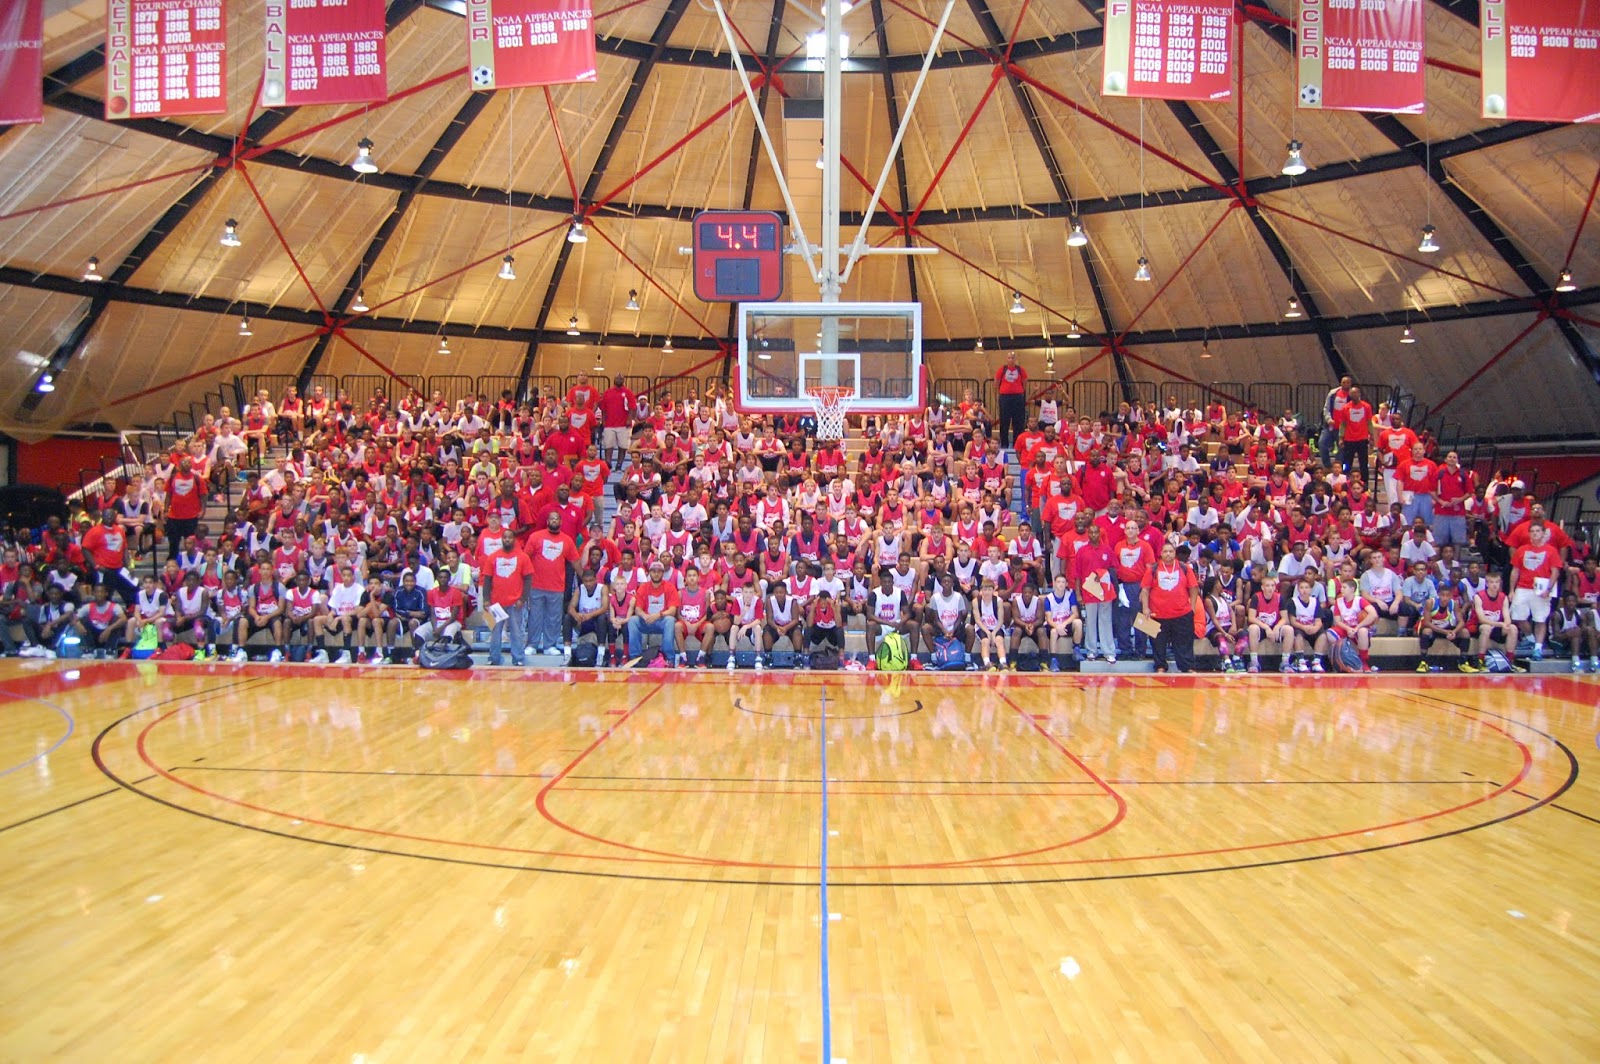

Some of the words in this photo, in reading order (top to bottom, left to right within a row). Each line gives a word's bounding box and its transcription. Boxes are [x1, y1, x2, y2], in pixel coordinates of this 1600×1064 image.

[135, 1, 180, 11] TOURNEY
[1136, 3, 1163, 12] NCAA
[1166, 5, 1232, 15] APPEARANCES
[165, 9, 189, 20] 1986
[196, 7, 220, 19] 1989
[493, 16, 522, 25] NCAA
[524, 10, 592, 23] APPEARANCES
[1136, 12, 1161, 23] 1993
[1169, 14, 1194, 25] 1994
[1202, 16, 1226, 27] 1995
[135, 23, 156, 34] 1991
[165, 21, 189, 32] 1992
[196, 19, 220, 31] 1993
[498, 24, 522, 36] 1997
[530, 21, 555, 33] 1998
[1168, 26, 1193, 37] 1997
[1202, 27, 1226, 39] 1998
[1510, 26, 1537, 34] NCAA
[1539, 27, 1600, 37] APPEARANCES
[135, 34, 158, 46] 1994
[165, 32, 191, 44] 2002
[288, 35, 316, 43] NCAA
[318, 31, 384, 42] APPEARANCES
[498, 36, 523, 48] 2001
[1168, 37, 1195, 49] 2000
[1201, 39, 1225, 50] 2001
[1324, 37, 1353, 46] NCAA
[1355, 39, 1423, 50] APPEARANCES
[1574, 38, 1597, 49] 2010
[131, 46, 158, 55] NCAA
[161, 42, 225, 54] APPEARANCES
[291, 45, 313, 56] 1981
[322, 43, 347, 54] 1982
[354, 41, 378, 53] 1983
[1328, 47, 1355, 58] 2004
[1360, 48, 1388, 59] 2005
[1511, 46, 1535, 57] 2013
[165, 53, 187, 65] 1981
[196, 51, 220, 63] 1985
[291, 56, 316, 67] 1984
[322, 55, 347, 66] 1989
[354, 53, 378, 65] 1990
[1167, 49, 1195, 61] 2004
[1200, 51, 1228, 62] 2005
[165, 65, 189, 76] 1987
[196, 63, 220, 75] 1989
[291, 67, 318, 79] 2003
[322, 66, 349, 77] 2005
[354, 64, 381, 75] 2006
[1167, 61, 1194, 72] 2009
[1200, 62, 1225, 74] 2010
[1328, 58, 1355, 69] 2008
[1360, 60, 1388, 71] 2009
[1393, 61, 1417, 73] 2010
[135, 78, 158, 90] 1990
[165, 77, 187, 88] 1991
[196, 75, 220, 87] 1992
[291, 79, 318, 90] 2007
[1166, 72, 1191, 84] 2013
[135, 90, 158, 101] 1993
[165, 88, 190, 100] 1994
[718, 225, 757, 249] 4.4
